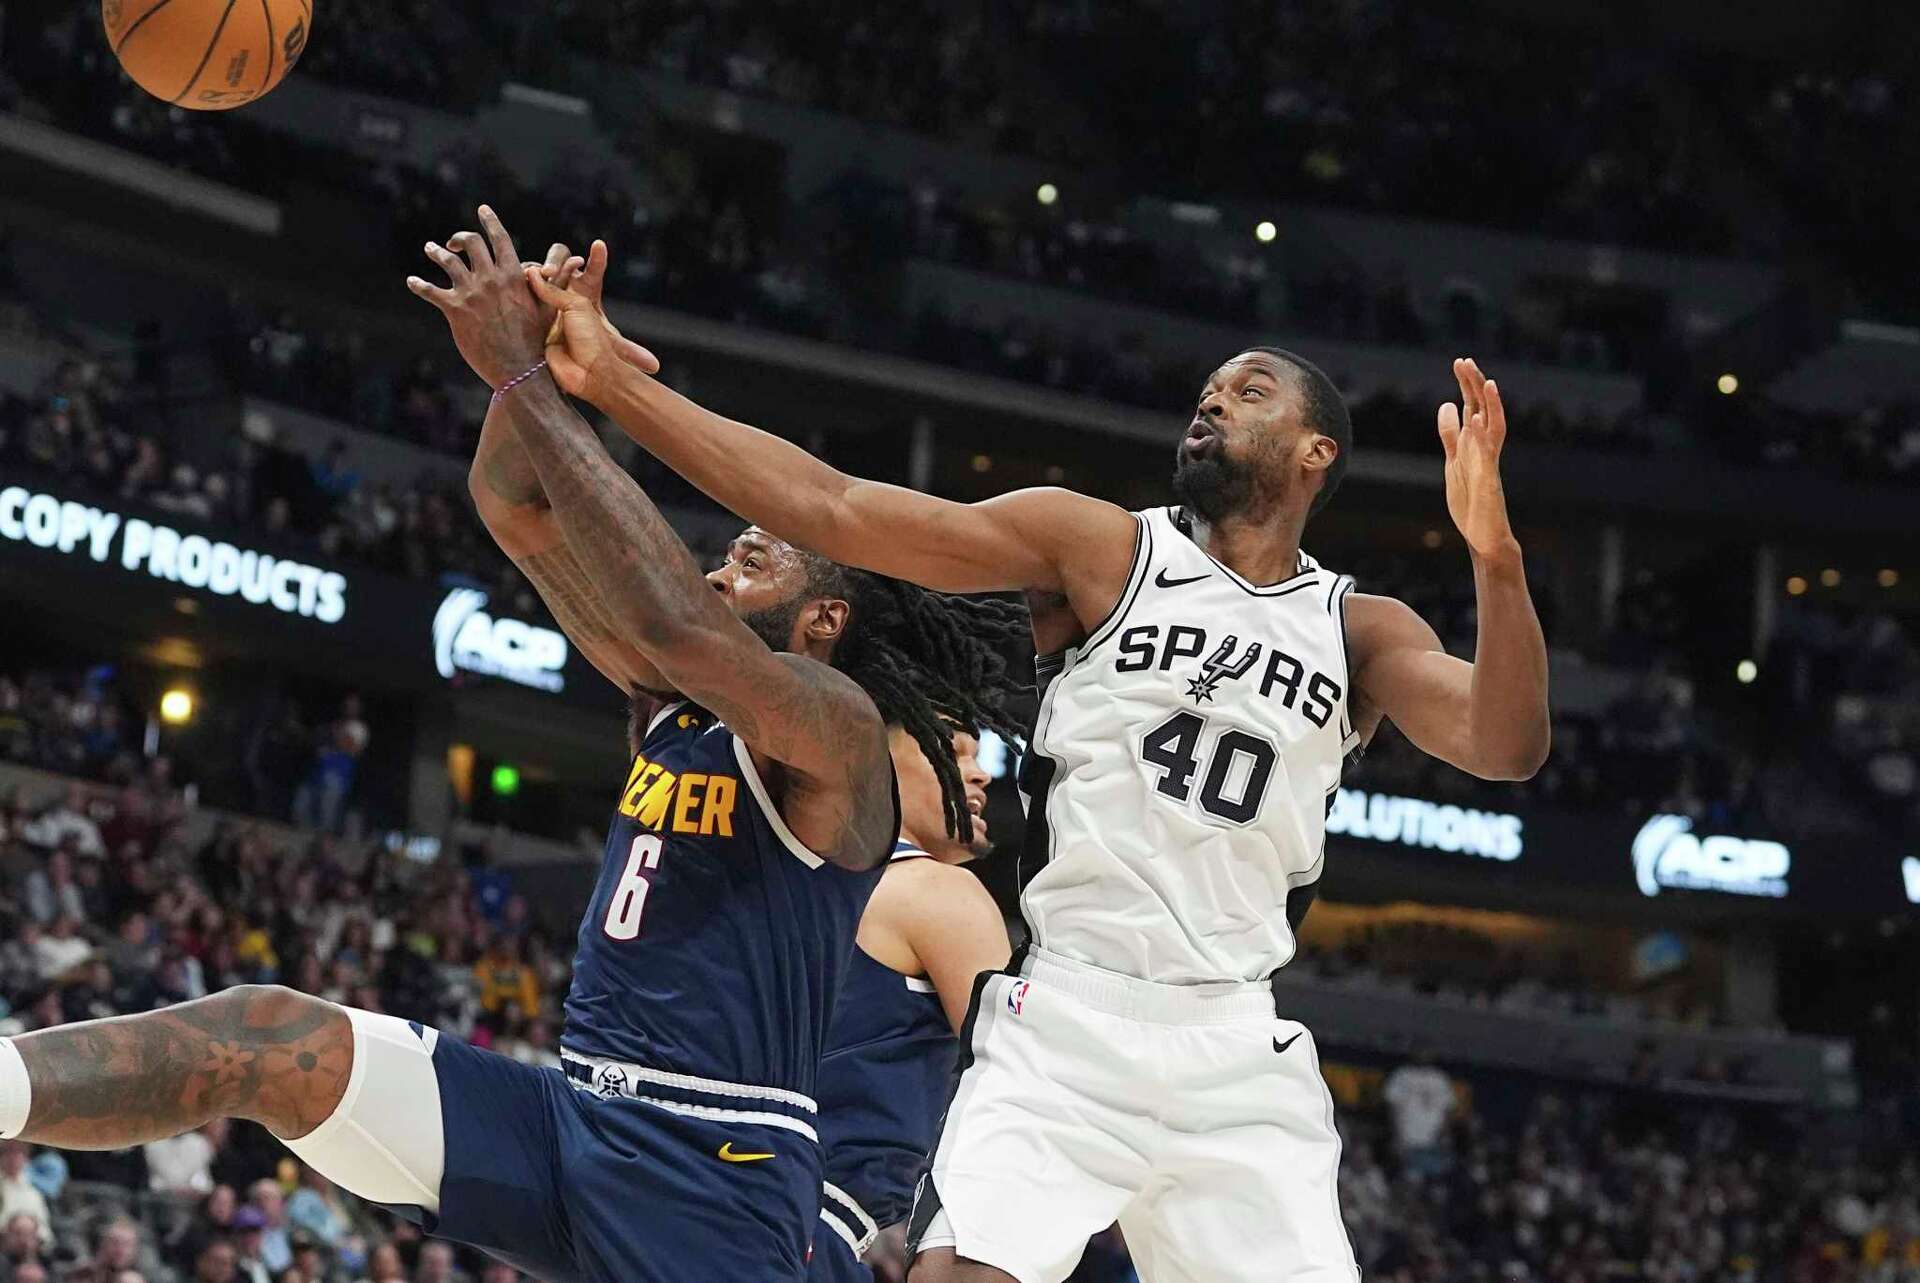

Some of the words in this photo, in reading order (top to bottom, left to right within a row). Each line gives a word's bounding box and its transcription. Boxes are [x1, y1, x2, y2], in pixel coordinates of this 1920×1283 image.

[0, 487, 120, 562] COPY
[121, 518, 346, 623] PRODUCTS
[1115, 625, 1342, 730] SPURS
[618, 754, 737, 838] ENER
[1138, 706, 1280, 828] 40
[1326, 786, 1523, 861] OLUTIONS
[603, 832, 665, 941] 6
